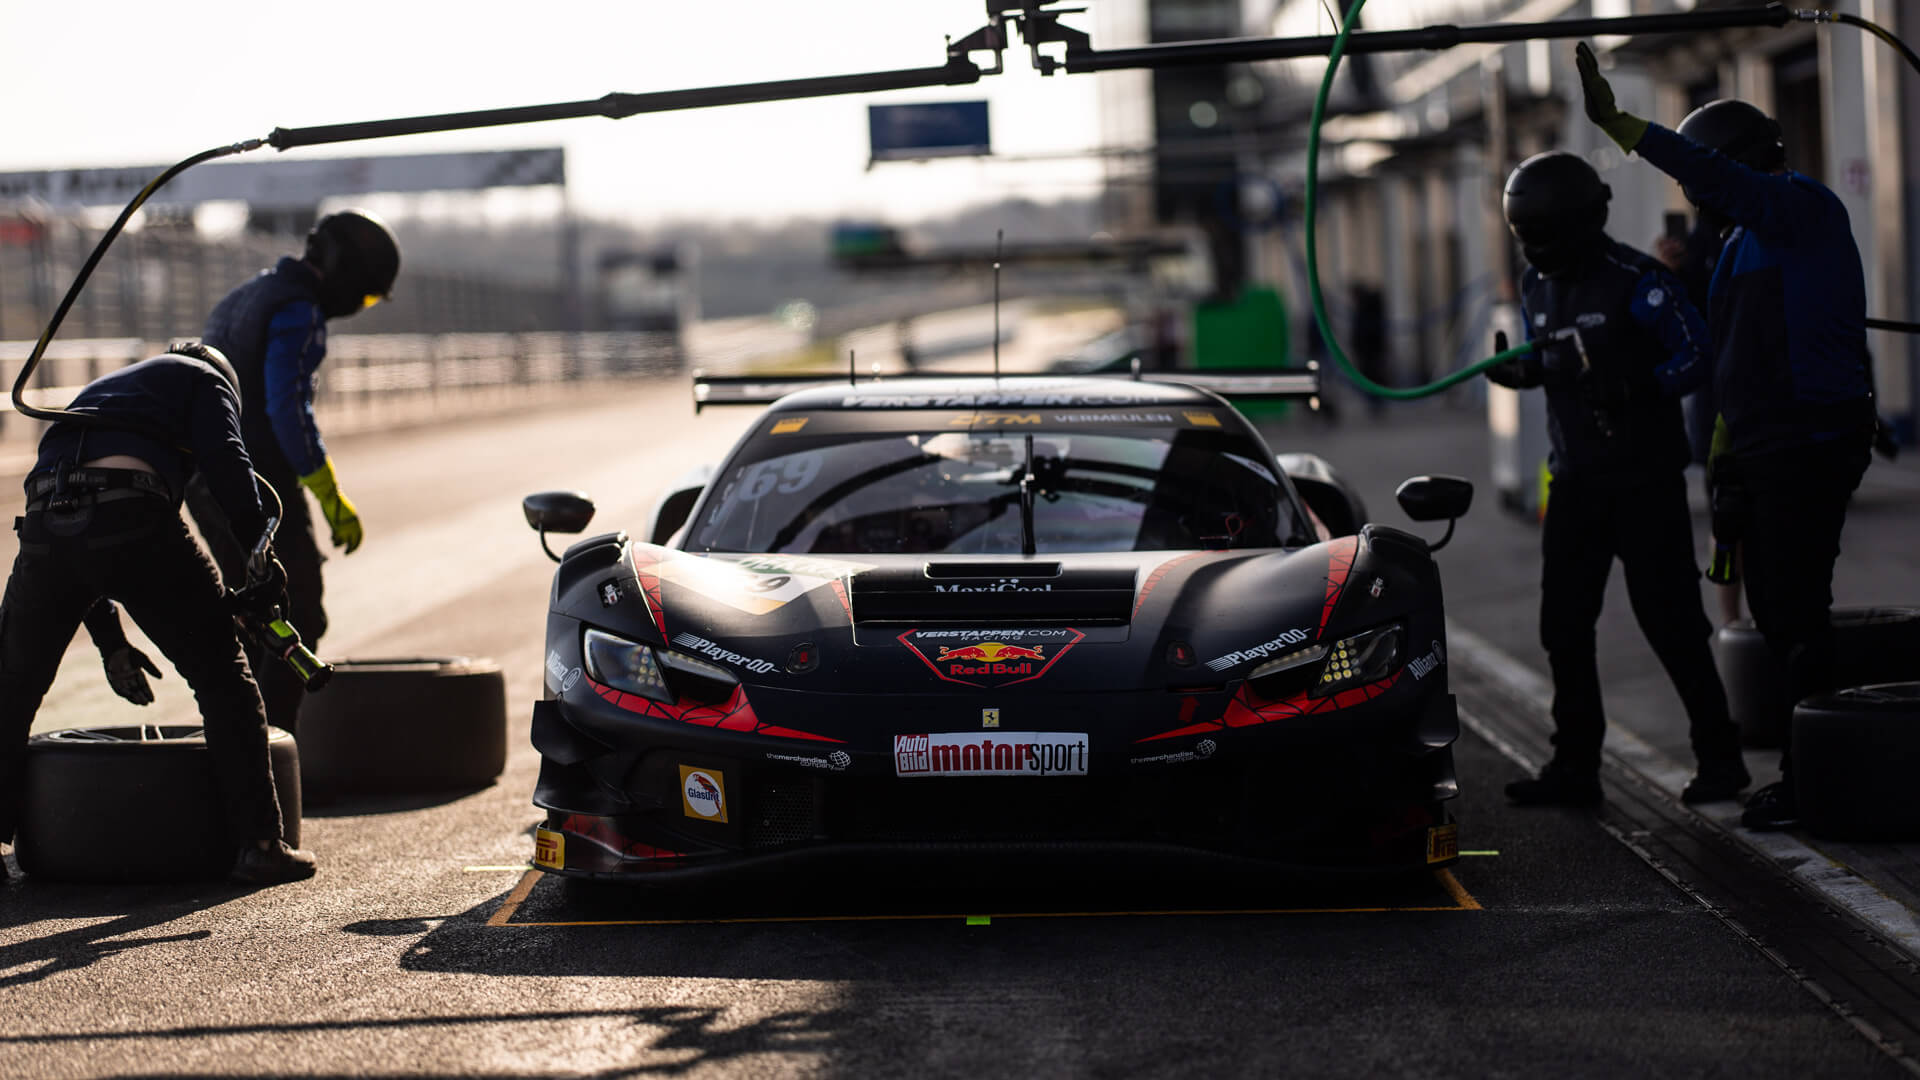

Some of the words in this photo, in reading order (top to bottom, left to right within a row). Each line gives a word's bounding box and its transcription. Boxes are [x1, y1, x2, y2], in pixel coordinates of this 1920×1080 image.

[1055, 413, 1173, 423] VERMEULEN
[739, 452, 824, 501] 69
[916, 629, 1068, 639] VERSTAPPEN.COM
[950, 664, 990, 675] Red
[993, 663, 1032, 674] Bull
[1408, 651, 1439, 681] Allianz
[897, 735, 928, 753] Auto
[900, 752, 929, 771] Bild
